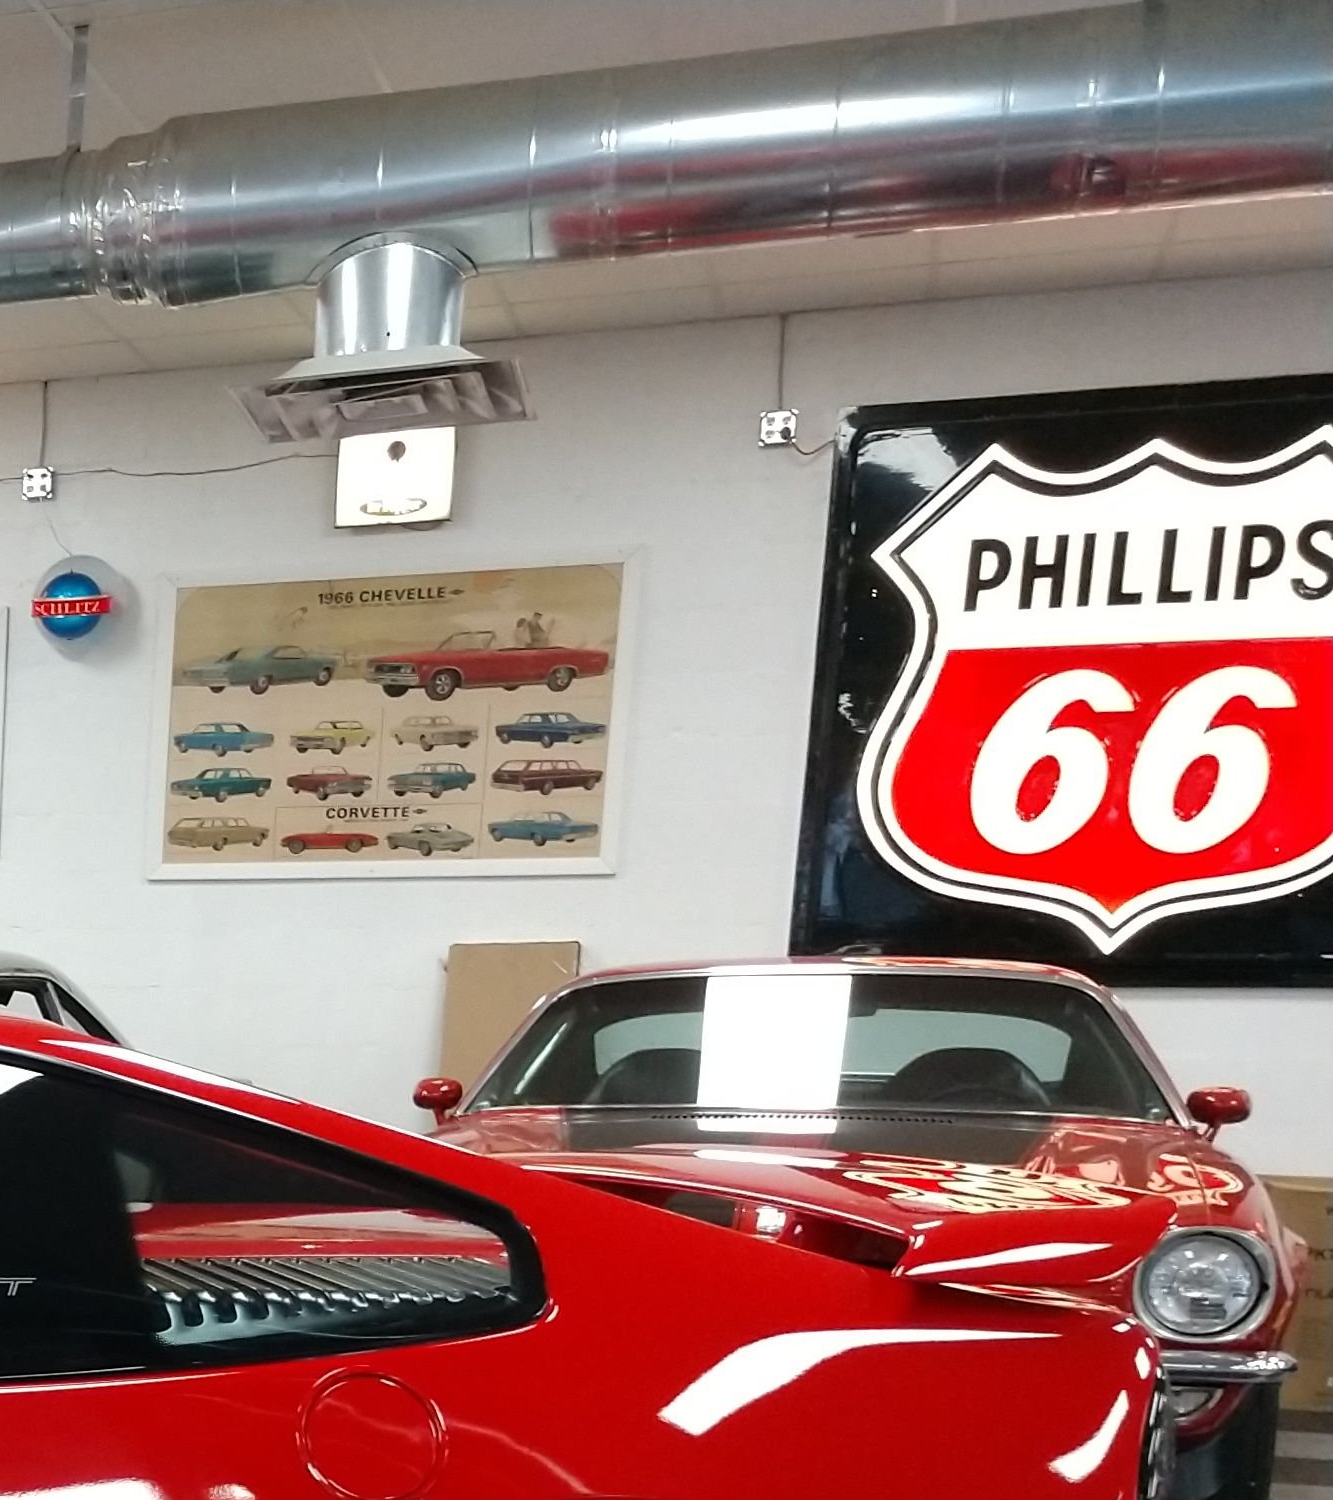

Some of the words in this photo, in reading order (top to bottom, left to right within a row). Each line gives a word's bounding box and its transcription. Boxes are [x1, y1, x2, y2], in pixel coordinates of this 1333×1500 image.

[964, 519, 1333, 613] PHILLIPS
[318, 591, 354, 605] 1966
[359, 586, 447, 603] CHEVELLE
[34, 600, 100, 616] SCHLITZ
[970, 665, 1298, 855] 66
[326, 806, 410, 819] CORVETTE
